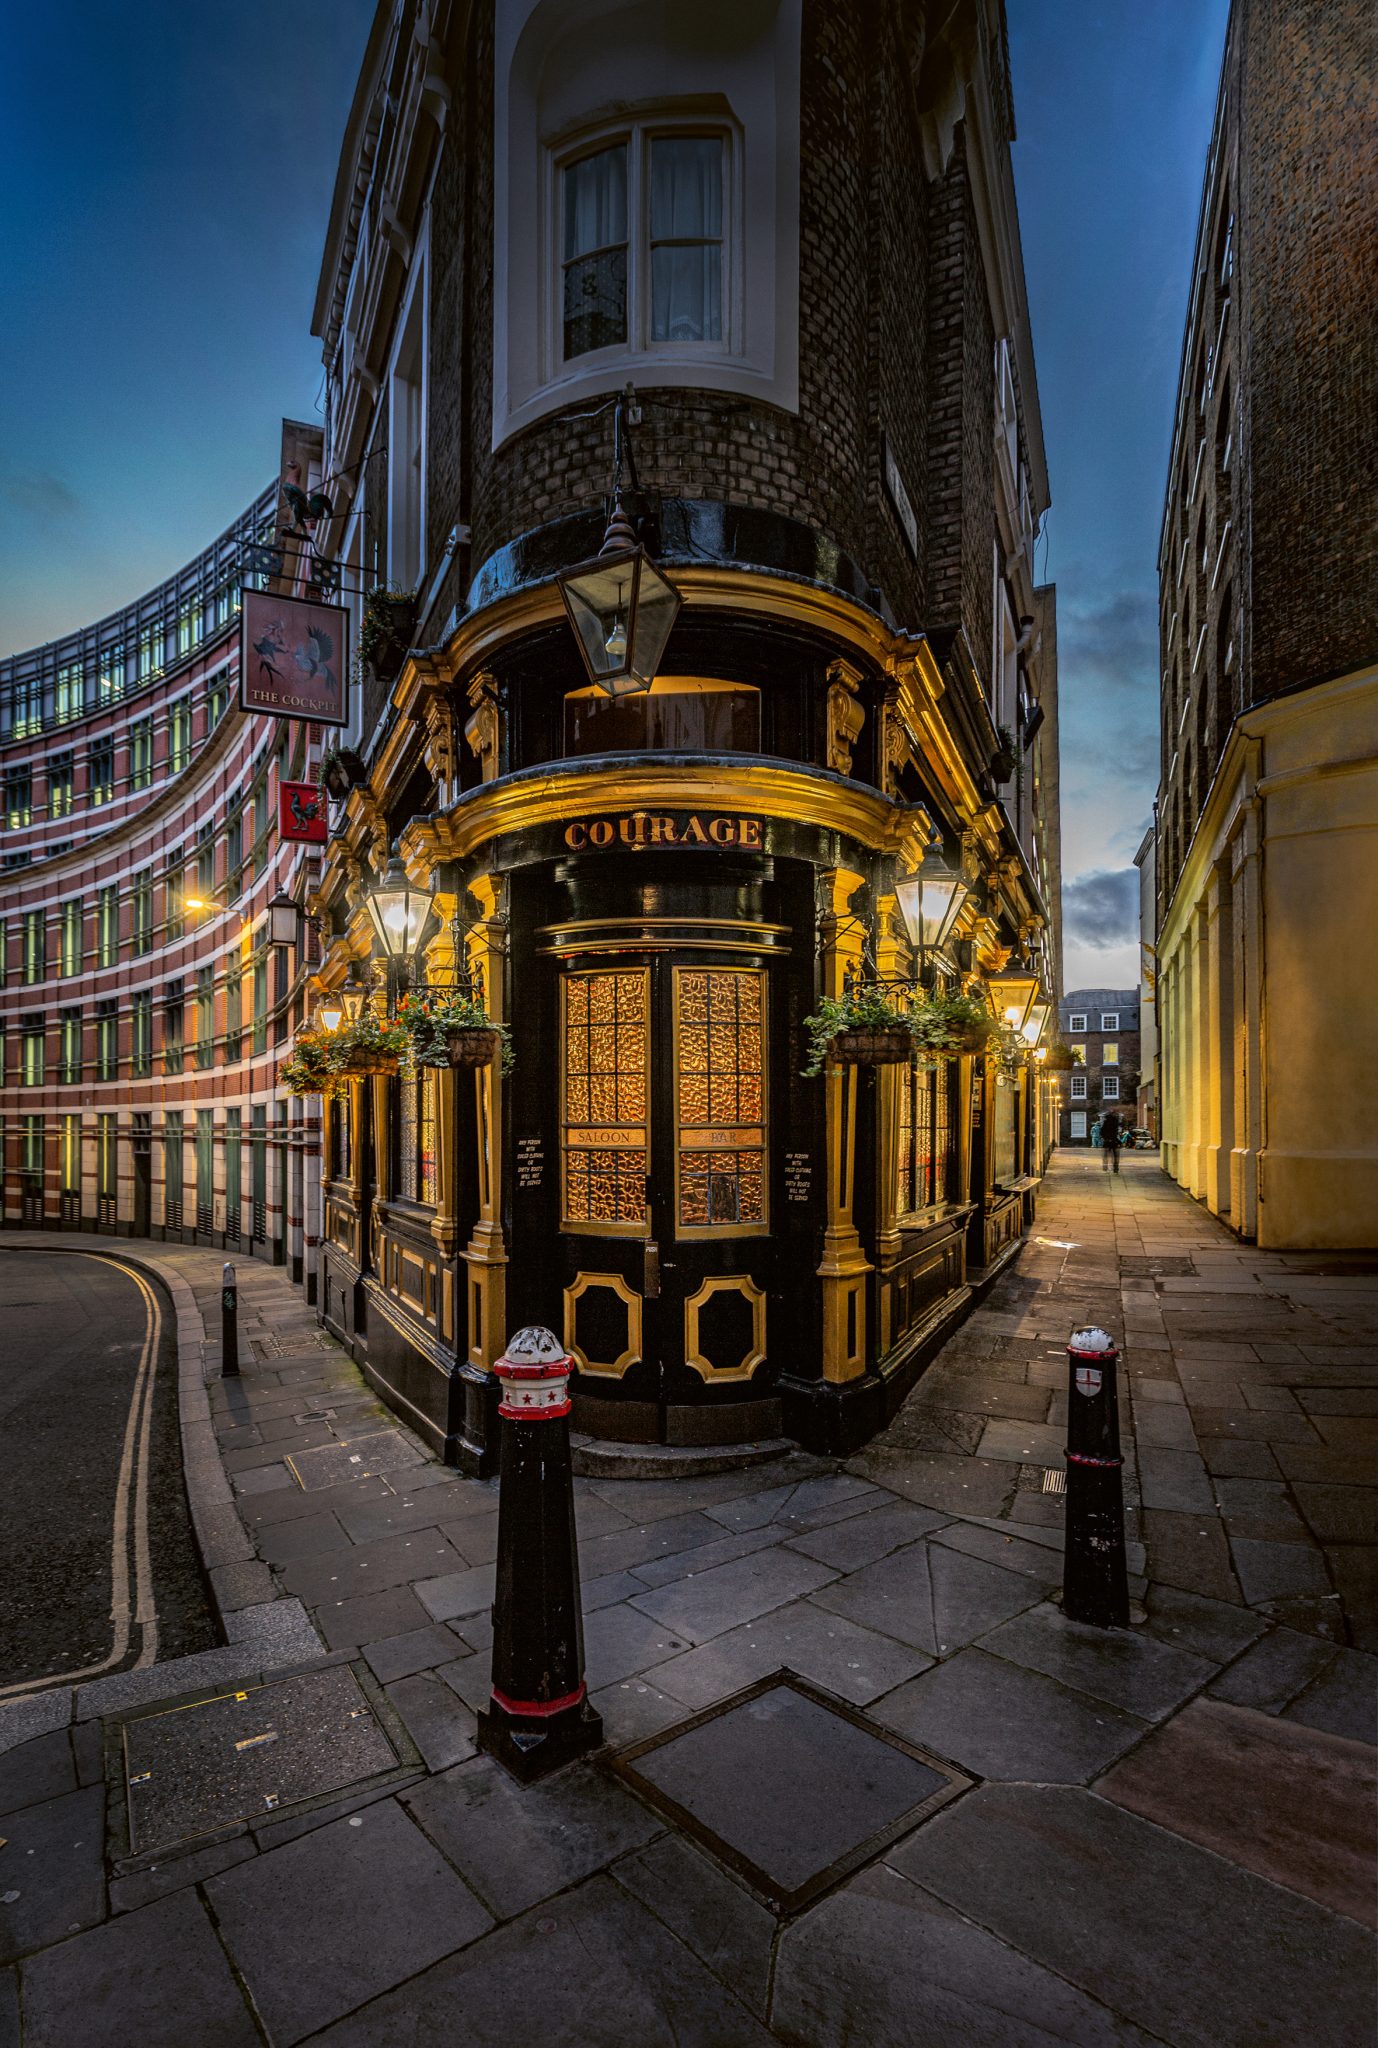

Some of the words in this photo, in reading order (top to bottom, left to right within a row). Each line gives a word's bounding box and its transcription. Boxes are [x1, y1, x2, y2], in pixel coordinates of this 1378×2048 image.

[251, 689, 279, 703] THE
[282, 694, 337, 712] COCKPIT
[564, 815, 763, 849] COURAGE
[577, 1131, 632, 1143] SALOON
[710, 1131, 737, 1144] BAR
